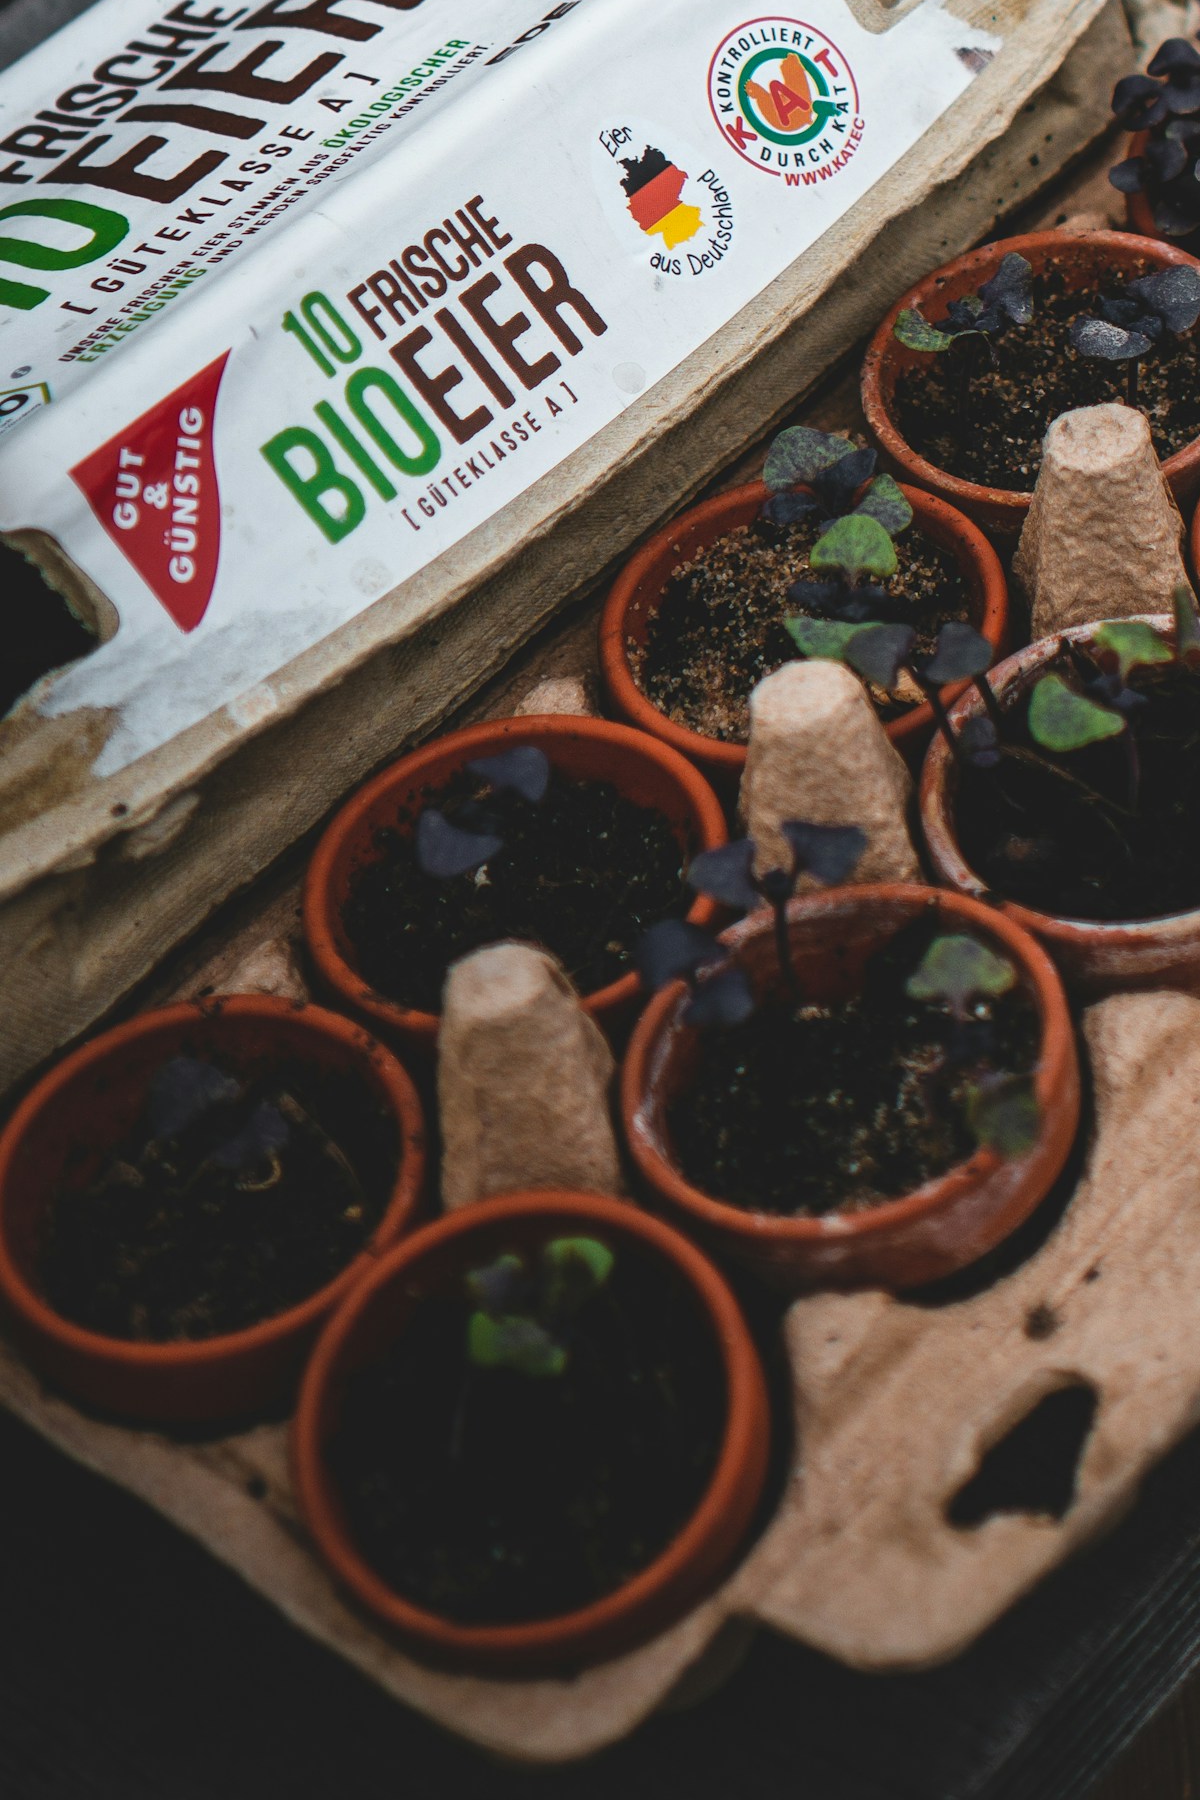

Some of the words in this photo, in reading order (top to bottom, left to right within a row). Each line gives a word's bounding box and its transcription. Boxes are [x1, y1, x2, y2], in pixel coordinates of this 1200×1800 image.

[717, 27, 815, 113] KONTROLLIERT
[760, 138, 834, 168] DURCH
[832, 86, 850, 133] KAT
[58, 316, 124, 362] UNSERE
[119, 260, 194, 314] FRISCHEN
[191, 232, 231, 257] EIER
[227, 177, 301, 229] STAMMEN
[298, 152, 331, 177] AUS
[322, 38, 471, 149] ÖKOLOGISCHER
[90, 124, 316, 293] GÜTEKLASSE
[317, 98, 354, 114] A
[599, 125, 633, 158] Eier
[784, 117, 866, 187] WWW.KAT.EC
[75, 267, 208, 362] ERZEUGUNG
[206, 239, 243, 265] UND
[242, 189, 307, 237] WERDEN
[306, 122, 392, 186] SORGFÄLTIG
[650, 252, 682, 275] aus
[686, 169, 733, 276] Deutschland
[281, 290, 364, 378] 10
[345, 195, 513, 341] FRISCHE
[259, 243, 609, 546] BIOEIER
[112, 447, 145, 532] GUT
[141, 479, 169, 511] &
[163, 406, 204, 585] GÜNSTIG
[417, 411, 543, 520] GÜTEKLASSE
[544, 392, 564, 417] A
